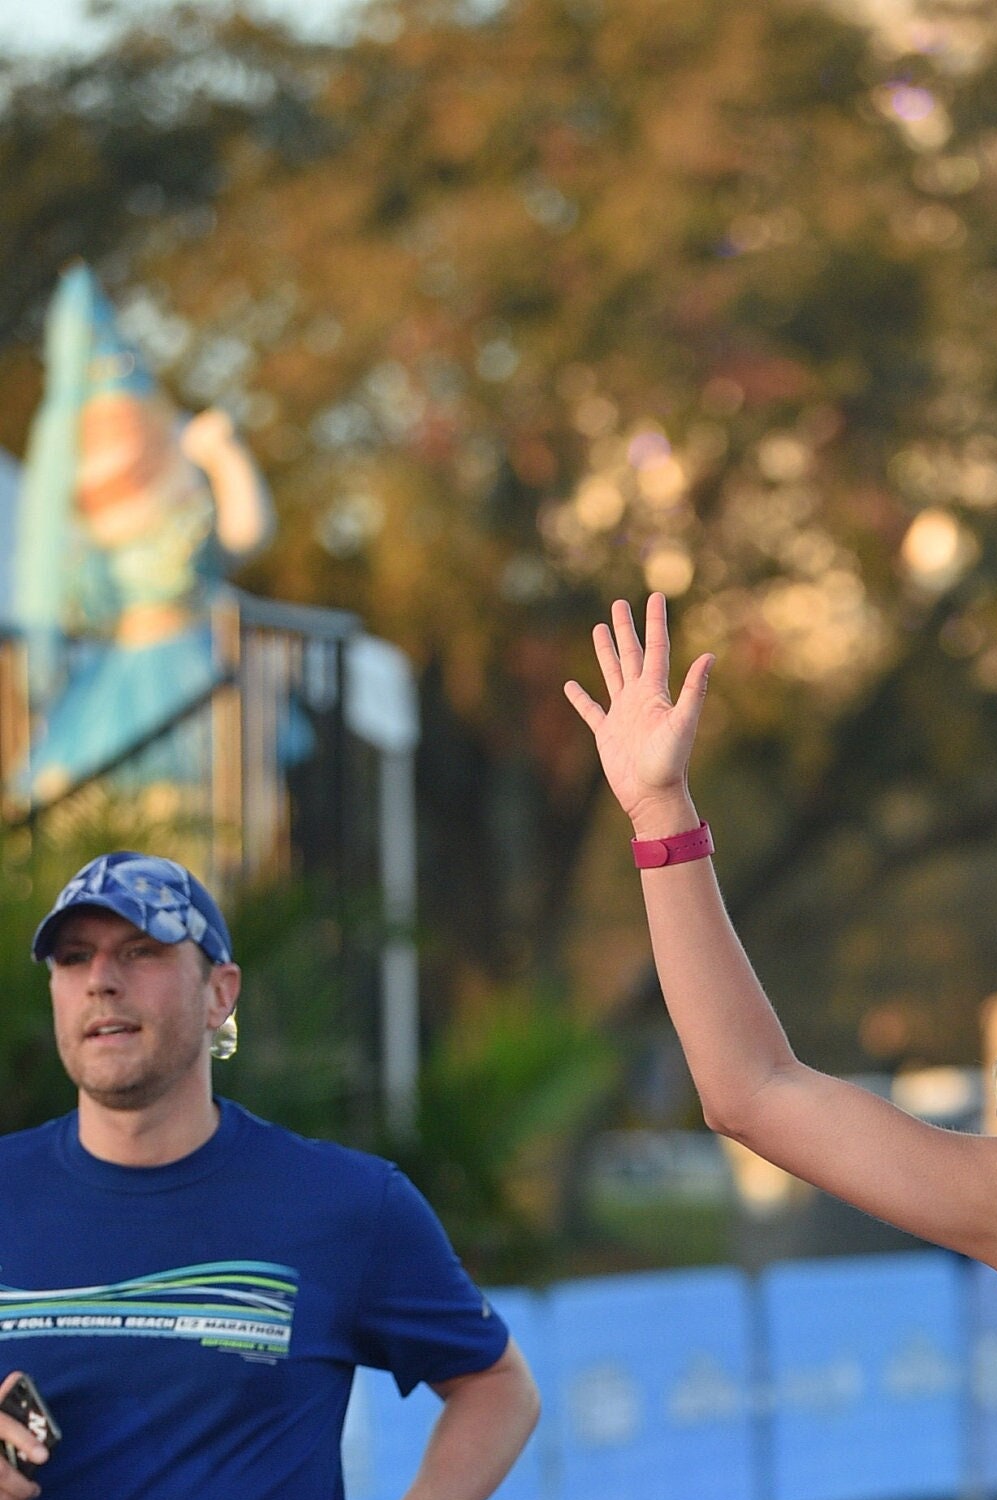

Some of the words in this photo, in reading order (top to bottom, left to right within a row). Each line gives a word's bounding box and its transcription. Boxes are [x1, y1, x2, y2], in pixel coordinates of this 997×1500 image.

[56, 1316, 122, 1329] VIRGINIA
[124, 1316, 174, 1329] BEACH
[204, 1319, 285, 1337] MARATHON
